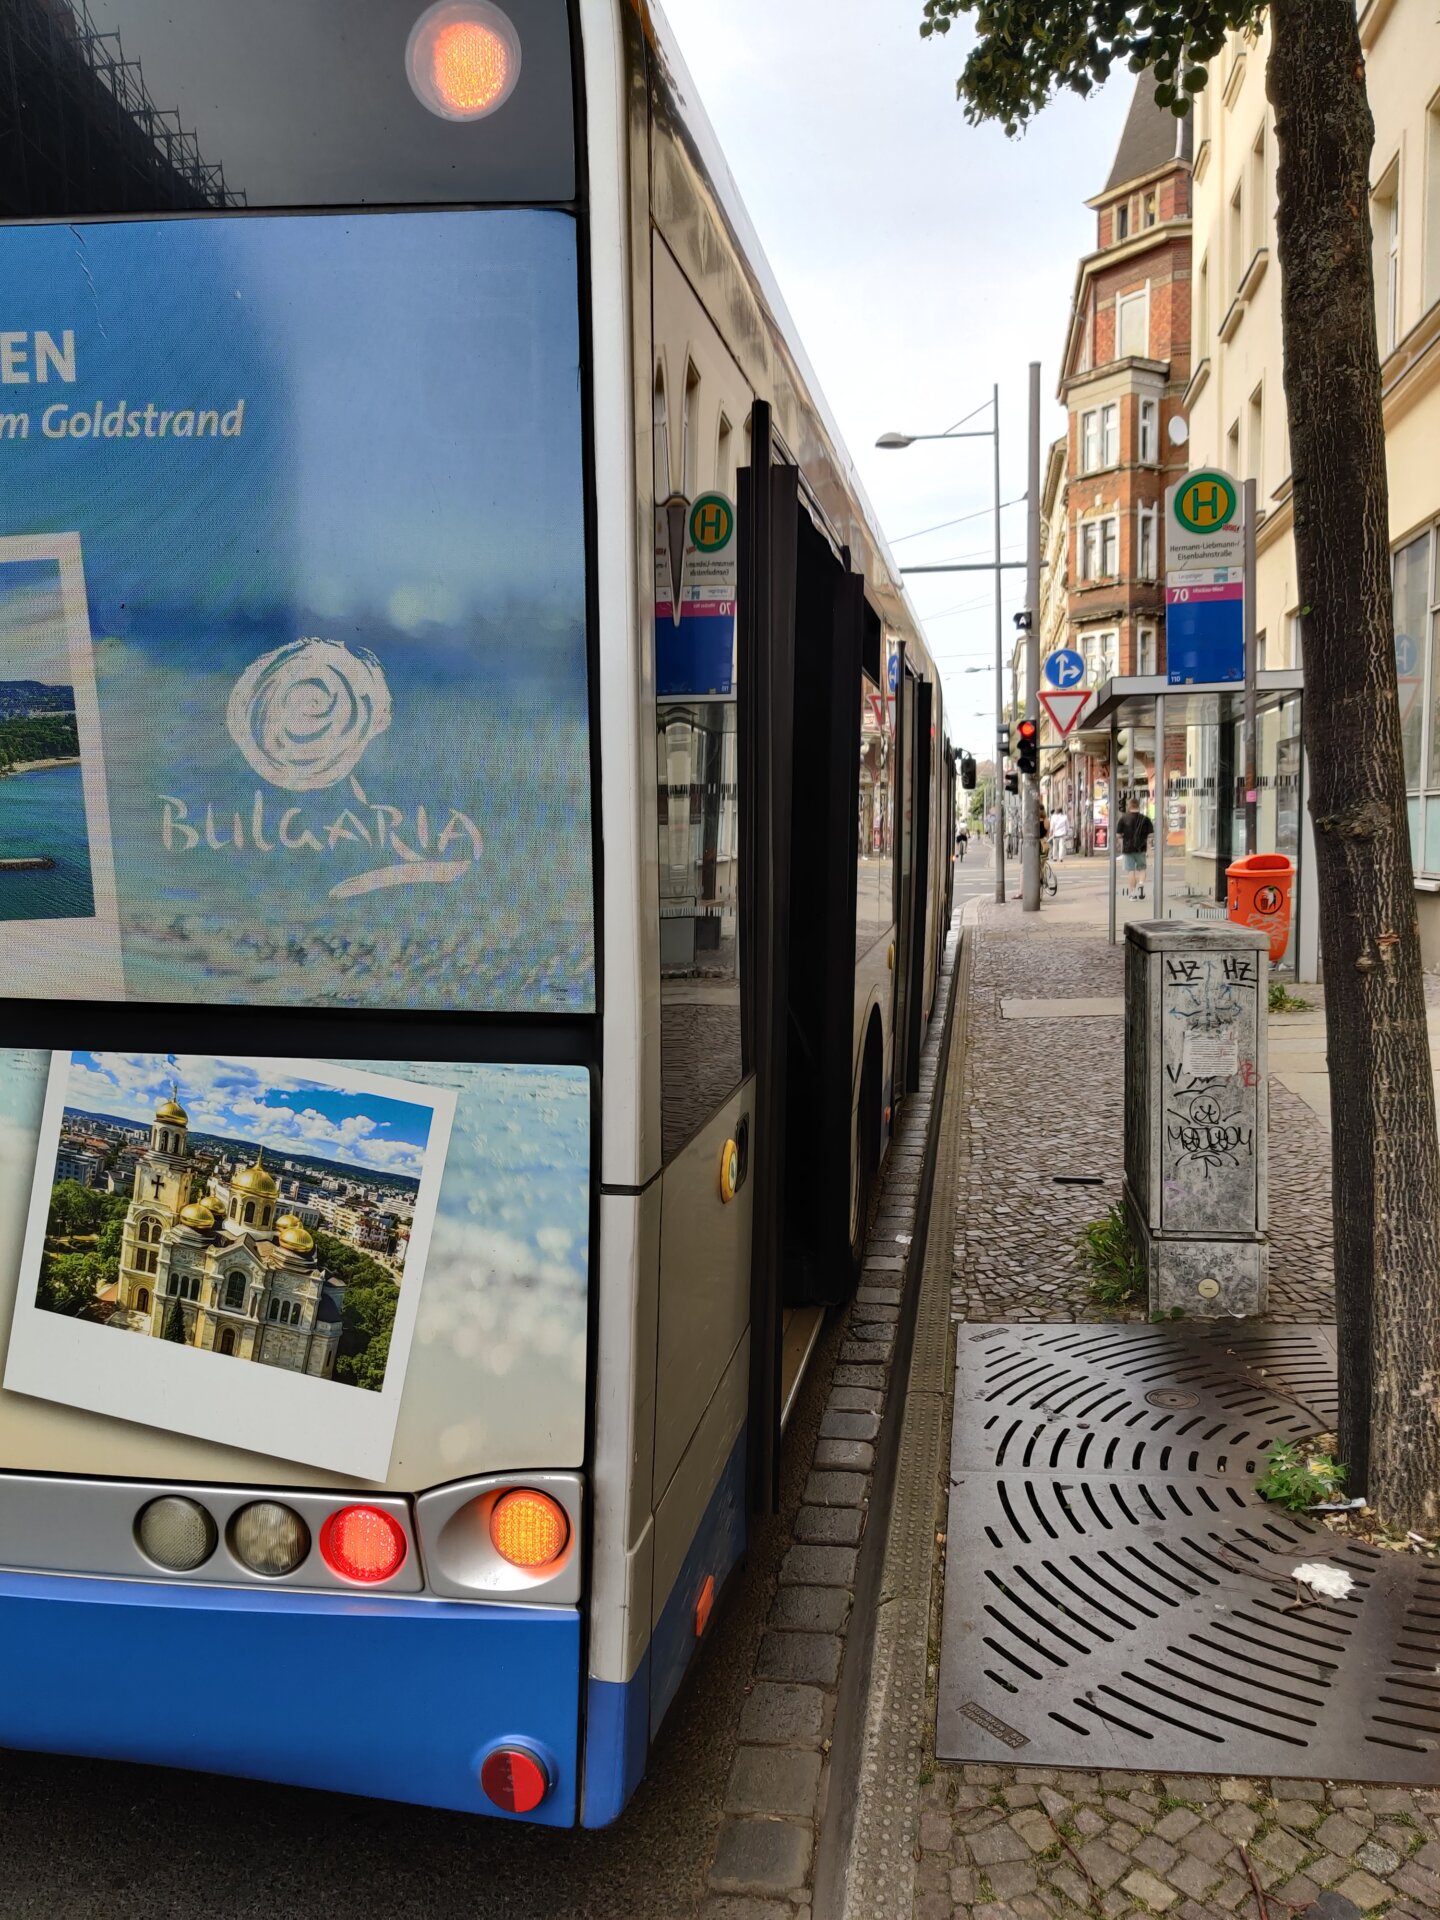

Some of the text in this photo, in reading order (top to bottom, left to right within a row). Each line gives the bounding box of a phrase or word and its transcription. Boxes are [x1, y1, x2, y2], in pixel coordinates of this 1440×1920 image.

[0, 330, 77, 385] EN
[42, 399, 246, 440] Goldstrand
[1193, 486, 1218, 521] H
[1177, 549, 1233, 561] Eisenbahnstraße
[1172, 587, 1190, 603] 70
[1170, 675, 1181, 683] 110
